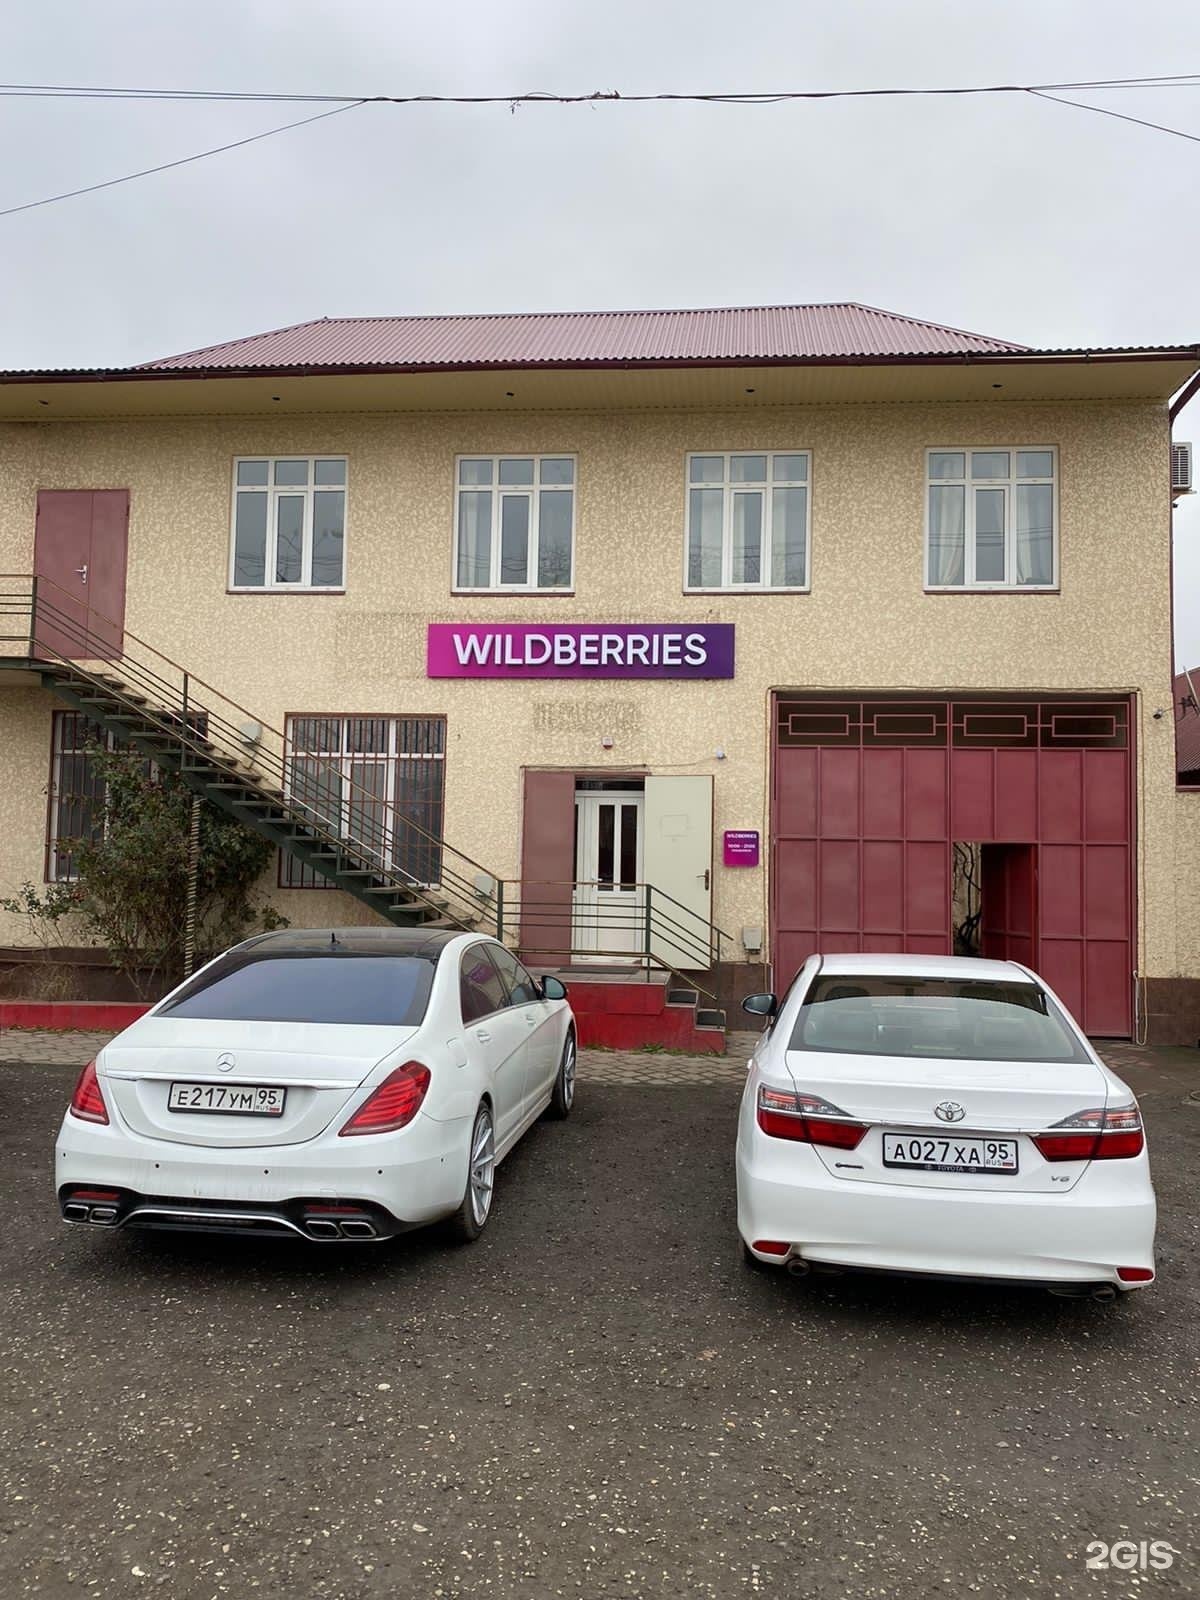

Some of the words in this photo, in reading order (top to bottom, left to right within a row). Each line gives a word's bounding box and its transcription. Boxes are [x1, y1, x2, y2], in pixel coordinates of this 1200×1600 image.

[452, 633, 708, 666] WILDBERRIES
[258, 1090, 277, 1105] 95
[987, 1143, 1009, 1160] 95
